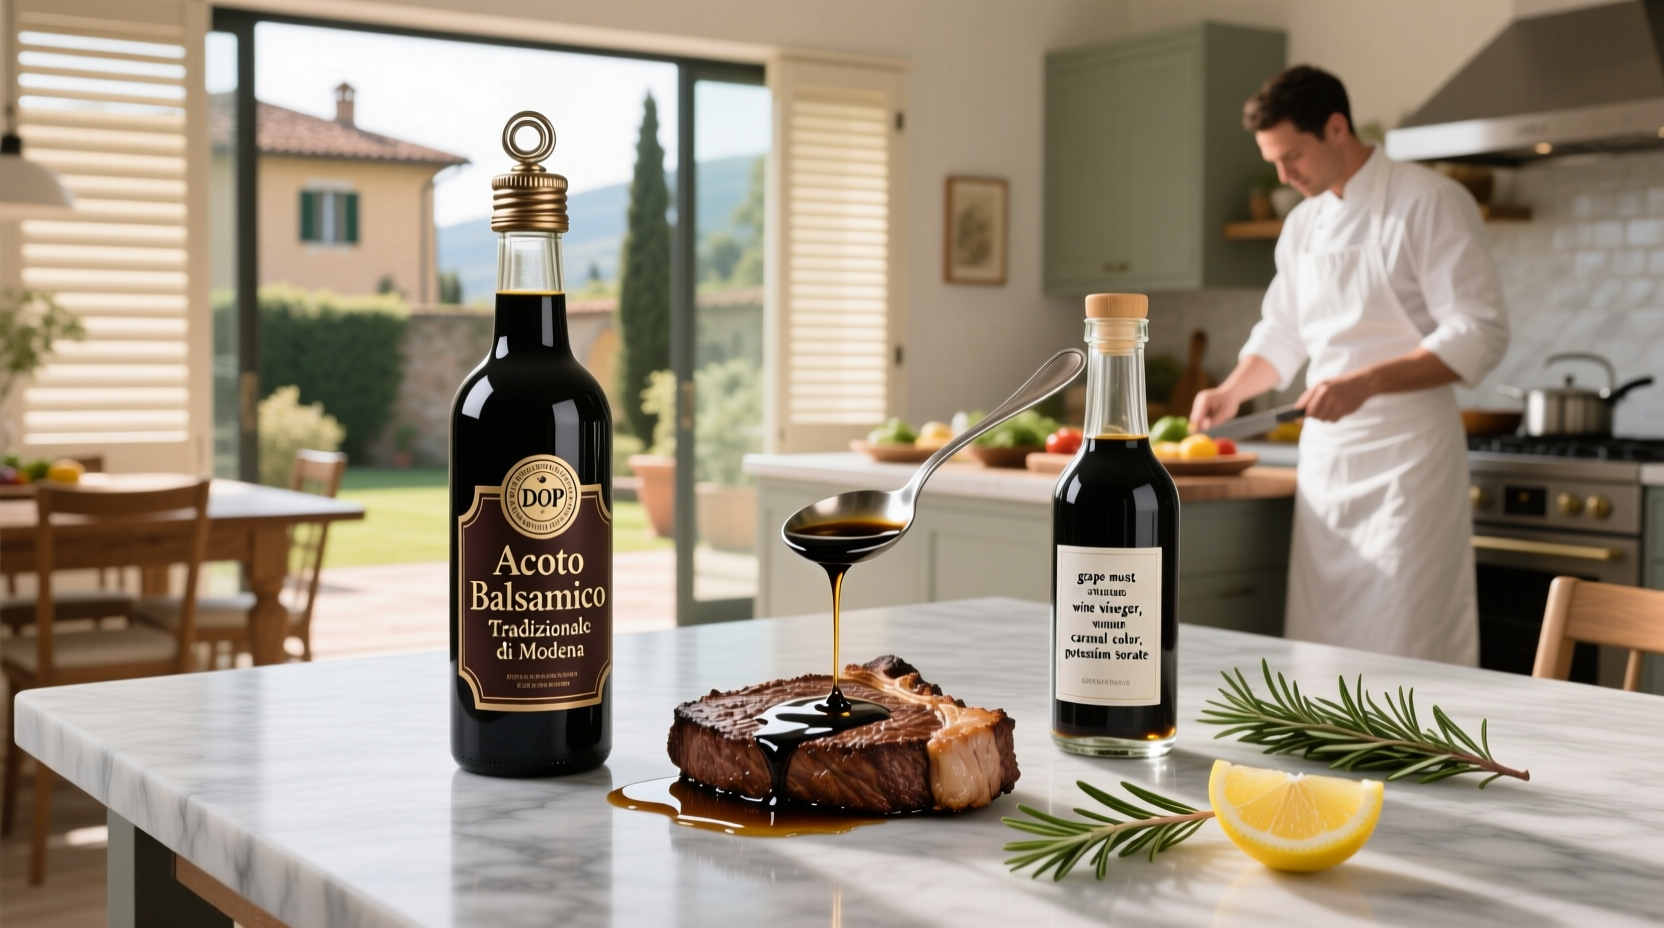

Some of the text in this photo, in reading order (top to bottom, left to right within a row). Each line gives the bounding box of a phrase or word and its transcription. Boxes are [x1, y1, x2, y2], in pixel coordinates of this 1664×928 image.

[521, 488, 565, 508] DOP
[492, 544, 585, 576] Acoto
[1109, 572, 1136, 583] must
[470, 580, 606, 612] Balsamico
[1072, 601, 1095, 613] wine
[496, 641, 585, 660] di Modena
